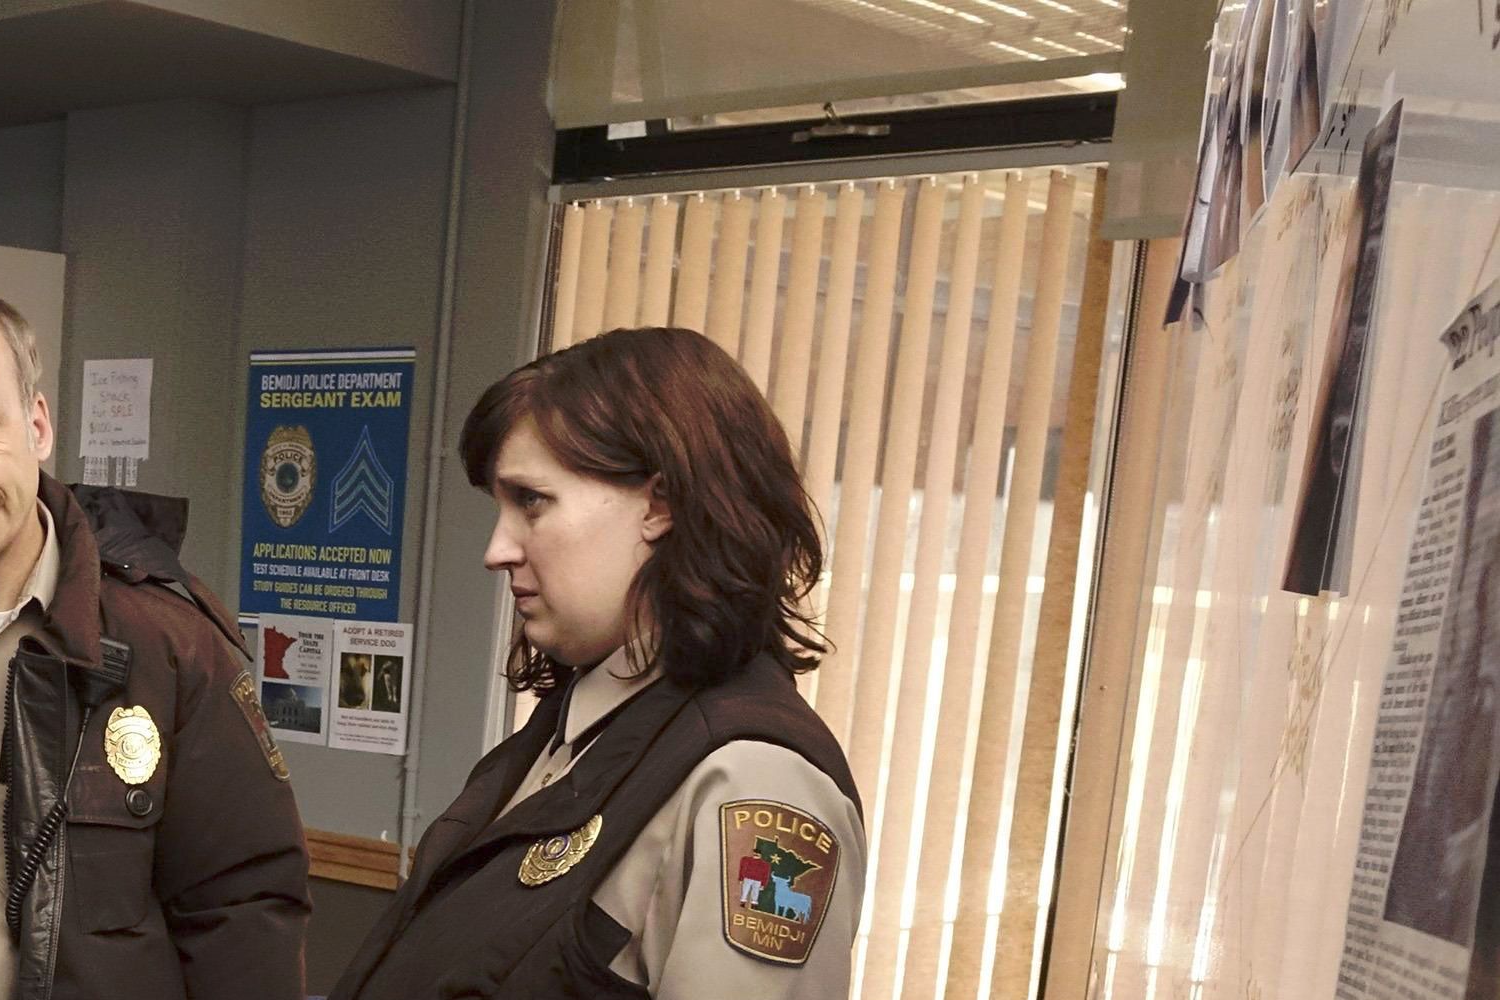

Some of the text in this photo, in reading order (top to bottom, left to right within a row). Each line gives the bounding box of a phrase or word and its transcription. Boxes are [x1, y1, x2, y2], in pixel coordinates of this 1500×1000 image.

[261, 372, 403, 391] BEMIDJI POLICE DEPARTMENT
[260, 391, 402, 408] SERGEANT EXAM
[273, 452, 302, 464] POLICE
[253, 542, 392, 565] APPLICATIONS ACCEPTED NOW
[253, 563, 390, 582] TEST SCHEDULE AVAILABLE AT FRONT DESK
[253, 580, 388, 599] STUDY GUIDES CAN BE ORDERED THROUGH
[280, 598, 357, 615] THE RESOURCE OFFICER
[343, 627, 365, 635] ADOPT
[374, 628, 405, 637] RETIRED
[350, 638, 396, 648] SERVICE DOG
[733, 809, 833, 855] POLICE
[732, 912, 806, 945] BEMIDJI
[752, 930, 784, 952] MN
